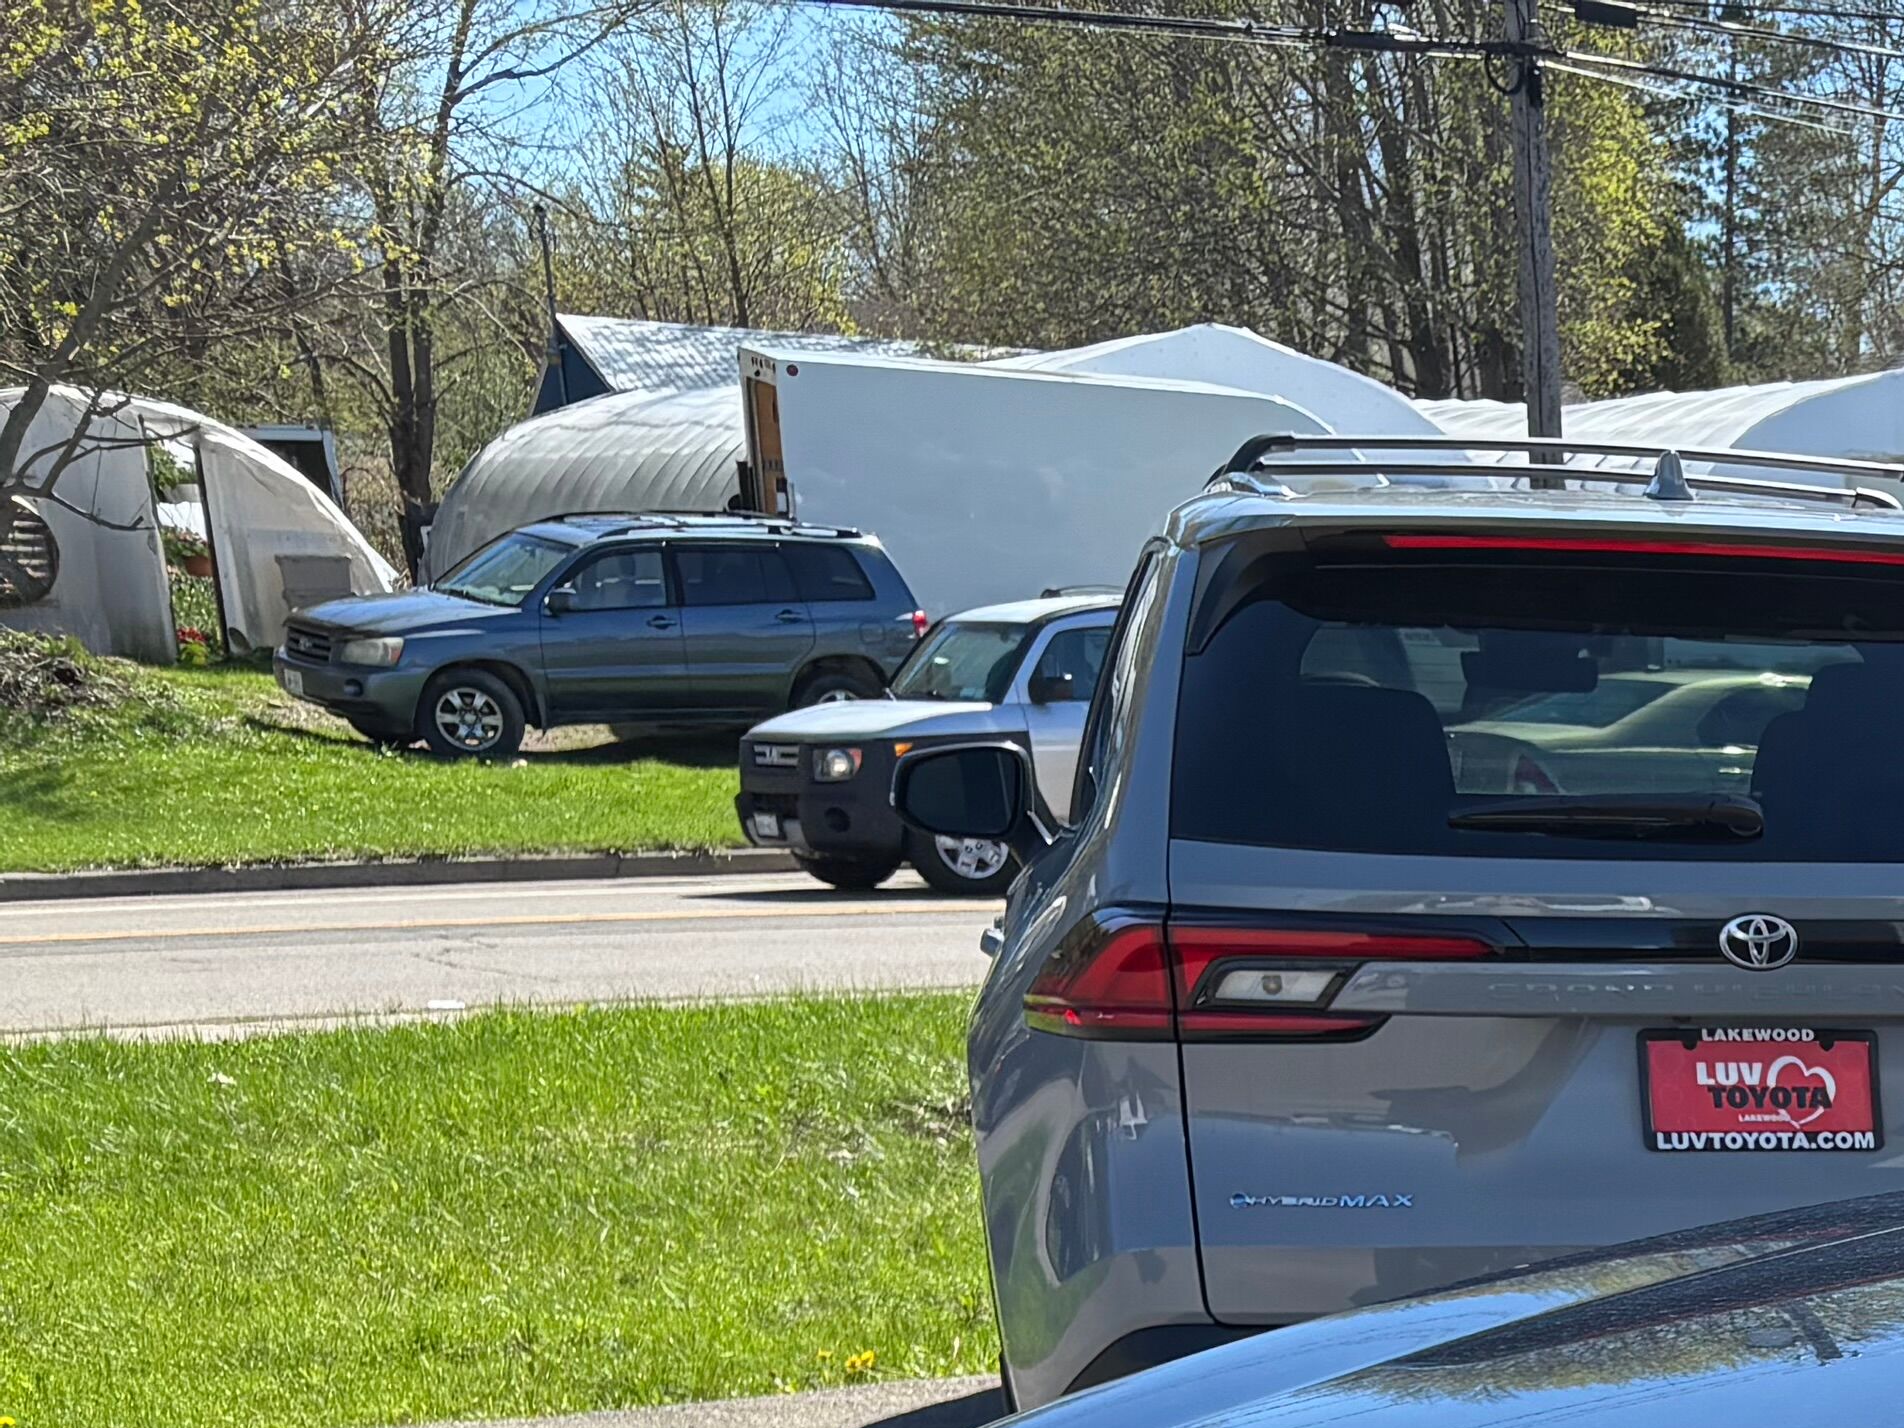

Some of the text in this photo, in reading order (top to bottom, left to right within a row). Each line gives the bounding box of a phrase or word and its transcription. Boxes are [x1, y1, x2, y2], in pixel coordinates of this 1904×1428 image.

[1700, 1028, 1816, 1043] LAKEWOOD
[1695, 1061, 1763, 1086] LUV
[1707, 1085, 1834, 1109] TOYOTA
[1655, 1131, 1876, 1151] LUVTOYOTA.COM
[1339, 1193, 1414, 1209] MAX
